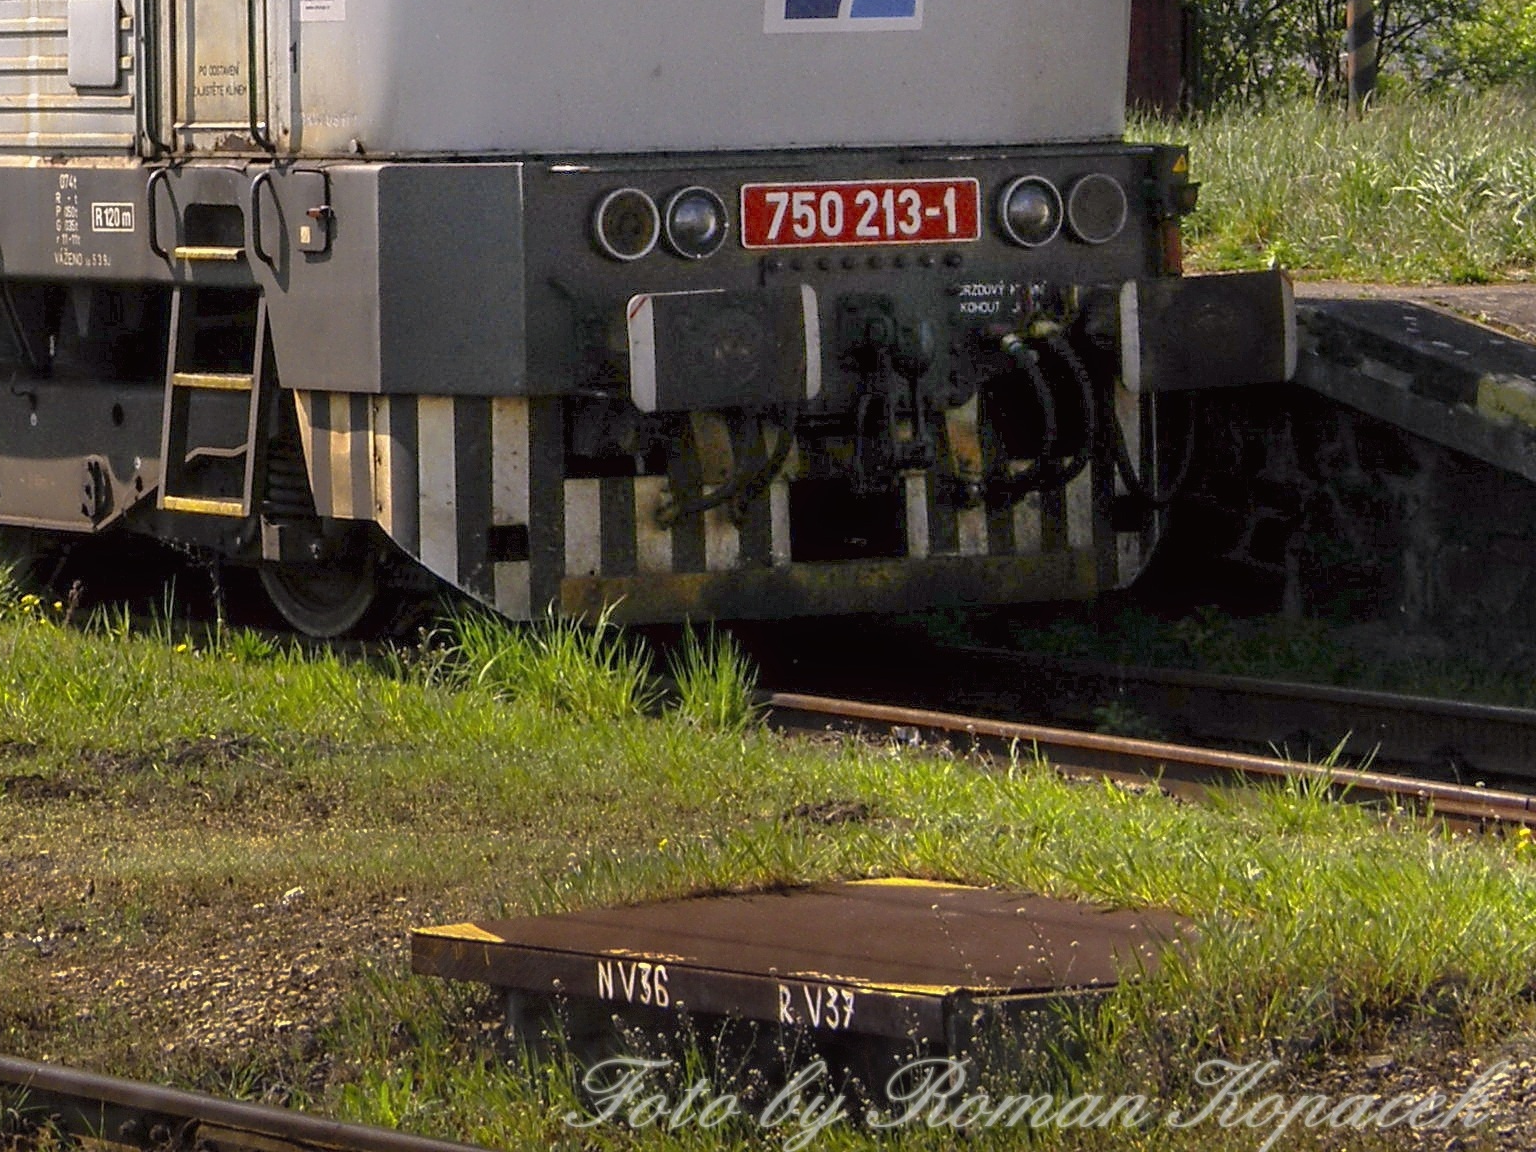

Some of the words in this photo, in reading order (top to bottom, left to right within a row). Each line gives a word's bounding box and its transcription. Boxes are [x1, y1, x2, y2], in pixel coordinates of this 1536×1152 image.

[95, 207, 103, 227] R
[103, 207, 120, 227] 120
[121, 210, 131, 227] m
[765, 190, 844, 240] 750
[855, 187, 957, 237] 213-1
